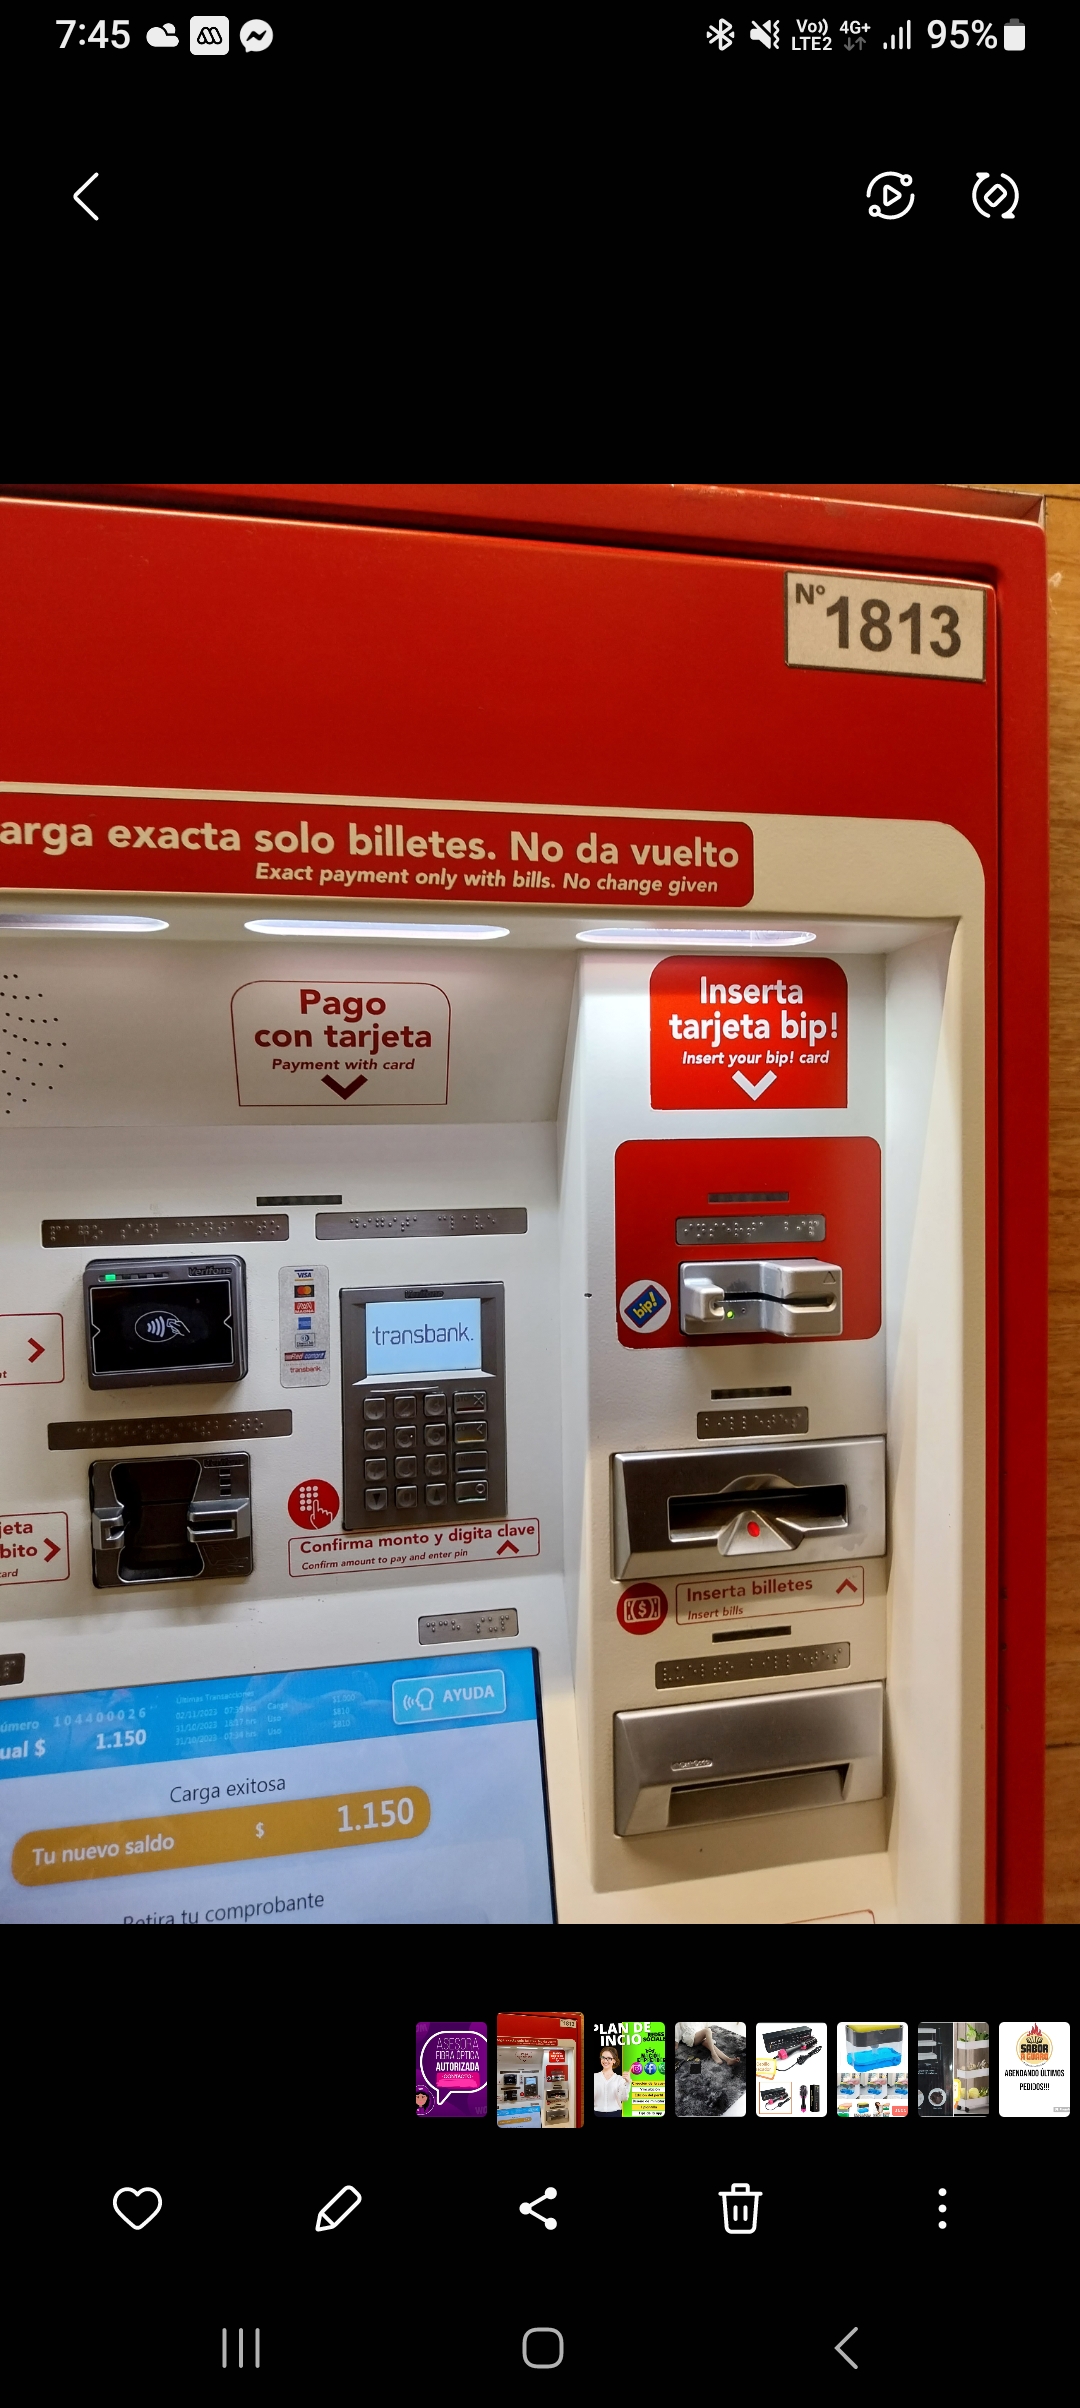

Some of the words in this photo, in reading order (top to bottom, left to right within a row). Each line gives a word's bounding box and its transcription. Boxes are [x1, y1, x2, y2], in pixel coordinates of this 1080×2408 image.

[826, 595, 961, 658] 1813
[107, 822, 241, 851] exacta
[254, 820, 335, 854] solo
[349, 822, 496, 860] billetes.
[510, 830, 564, 863] No
[576, 832, 618, 865] da
[631, 836, 739, 868] vuelto
[255, 862, 313, 882] Exact
[319, 866, 409, 887] payment
[415, 868, 458, 890] only
[463, 869, 506, 888] with
[512, 870, 556, 889] bills.
[563, 873, 590, 890] No
[596, 873, 663, 893] change
[668, 875, 718, 896] given
[700, 976, 803, 1005] Inserta
[300, 988, 386, 1023] Pago
[254, 1028, 313, 1048] con
[324, 1022, 432, 1056] tarjeta
[668, 1010, 770, 1048] tarjeta
[781, 1009, 839, 1047] bip!
[272, 1058, 340, 1073] Payment
[344, 1058, 378, 1070] with
[382, 1058, 416, 1070] card
[682, 1051, 724, 1065] Insert
[727, 1053, 762, 1068] your
[765, 1050, 795, 1067] bip!
[799, 1050, 830, 1064] card
[632, 1291, 658, 1319] bip!
[374, 1322, 475, 1346] transbank.
[300, 1537, 373, 1555] Confirma
[378, 1533, 430, 1548] monto
[434, 1532, 443, 1546] y
[448, 1526, 493, 1545] digita
[497, 1524, 536, 1539] clave
[301, 1560, 339, 1572] Confirm
[340, 1556, 376, 1568] amount
[378, 1556, 388, 1565] to
[390, 1555, 407, 1566] pay
[409, 1552, 426, 1562] and
[428, 1550, 453, 1561] enter
[454, 1548, 468, 1559] pin
[686, 1584, 746, 1603] Inserta
[751, 1576, 813, 1597] billetes
[687, 1608, 719, 1621] Insert
[722, 1605, 744, 1617] bills
[443, 1684, 495, 1703] AYUDA
[34, 1738, 46, 1758] $
[96, 1728, 147, 1750] 1.150
[170, 1785, 220, 1804] Carga
[226, 1777, 286, 1797] exitosa
[32, 1848, 56, 1866] Tu
[62, 1842, 120, 1863] nuevo
[125, 1833, 175, 1855] saldo
[255, 1821, 265, 1839] $
[337, 1797, 414, 1833] 1.150
[181, 1910, 199, 1924] tu
[205, 1892, 325, 1923] comprobante
[601, 2034, 642, 2047] INCIO
[634, 2022, 651, 2033] DE
[1020, 2044, 1049, 2053] SABOR
[436, 2062, 480, 2071] AUTORIZADA
